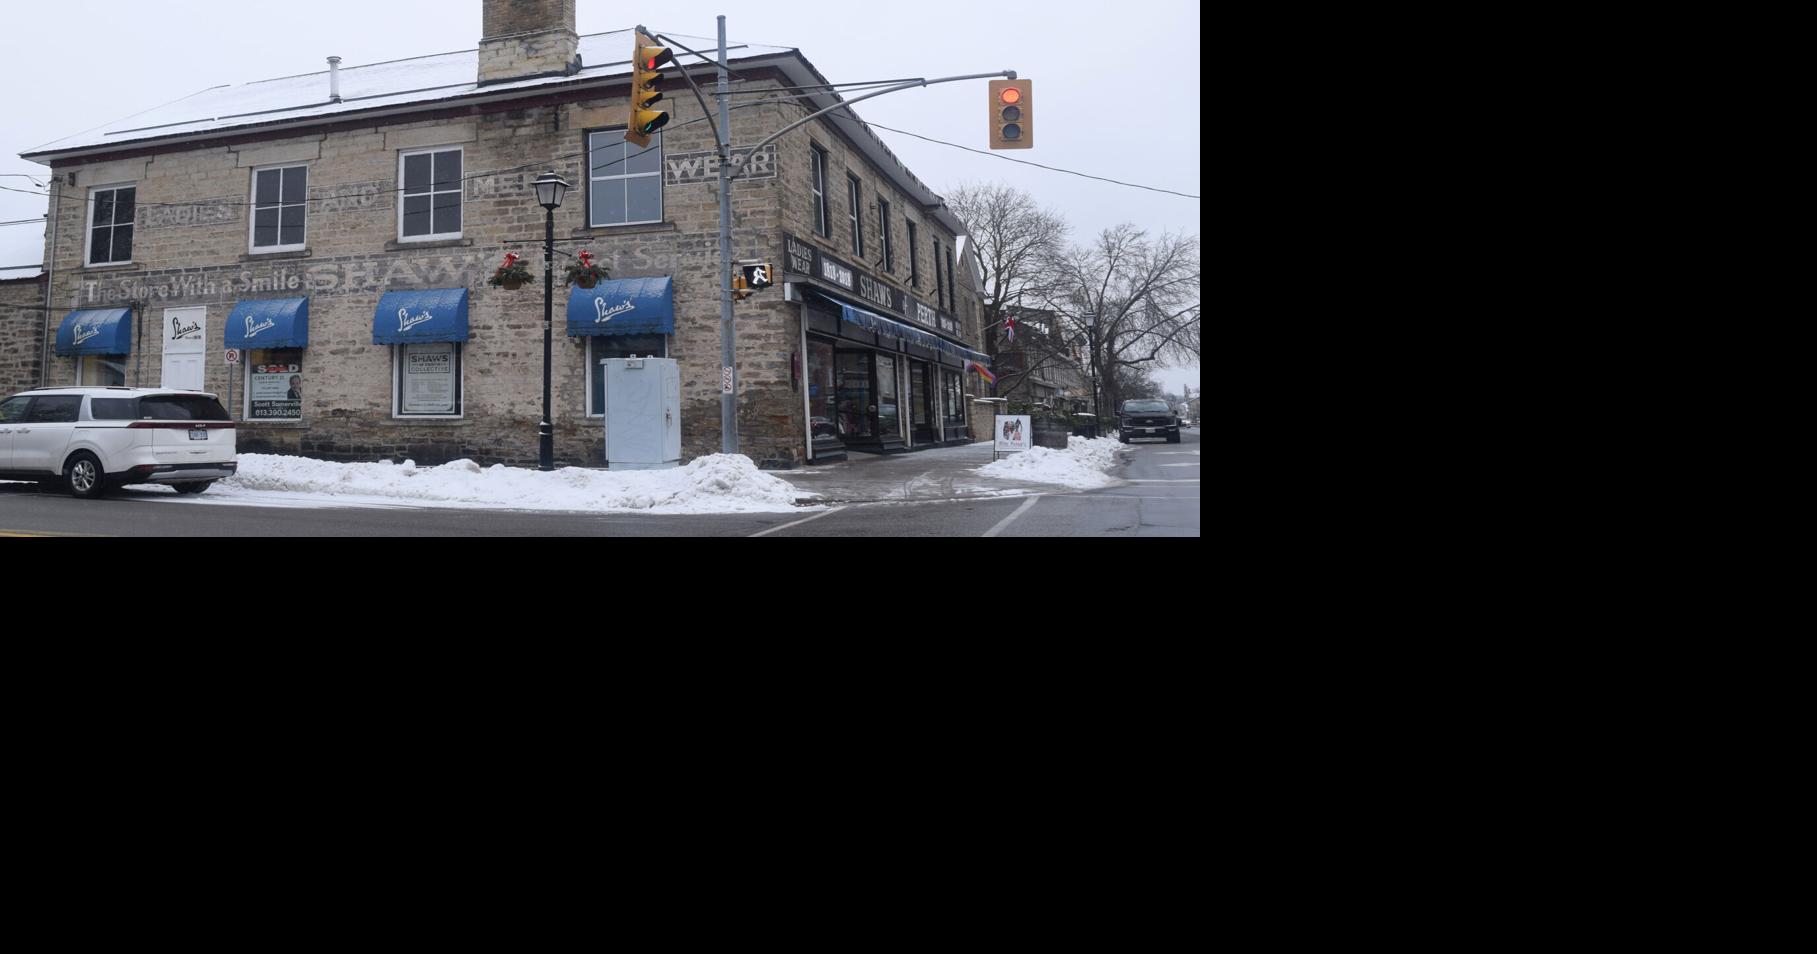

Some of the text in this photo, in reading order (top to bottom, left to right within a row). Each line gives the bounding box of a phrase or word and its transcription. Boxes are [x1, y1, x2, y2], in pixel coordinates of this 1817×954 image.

[788, 239, 812, 262] LADIES
[791, 254, 810, 275] WEAR
[85, 268, 300, 302] The Store With a Smile
[594, 296, 636, 323] Shaw's
[860, 275, 892, 308] SHAWS
[917, 302, 937, 328] PERTH
[172, 317, 201, 339] Shaw's
[244, 315, 275, 338] Shaw's
[397, 308, 433, 332] Shaw's
[73, 323, 99, 345] Shaw's
[411, 354, 449, 362] SHAWS
